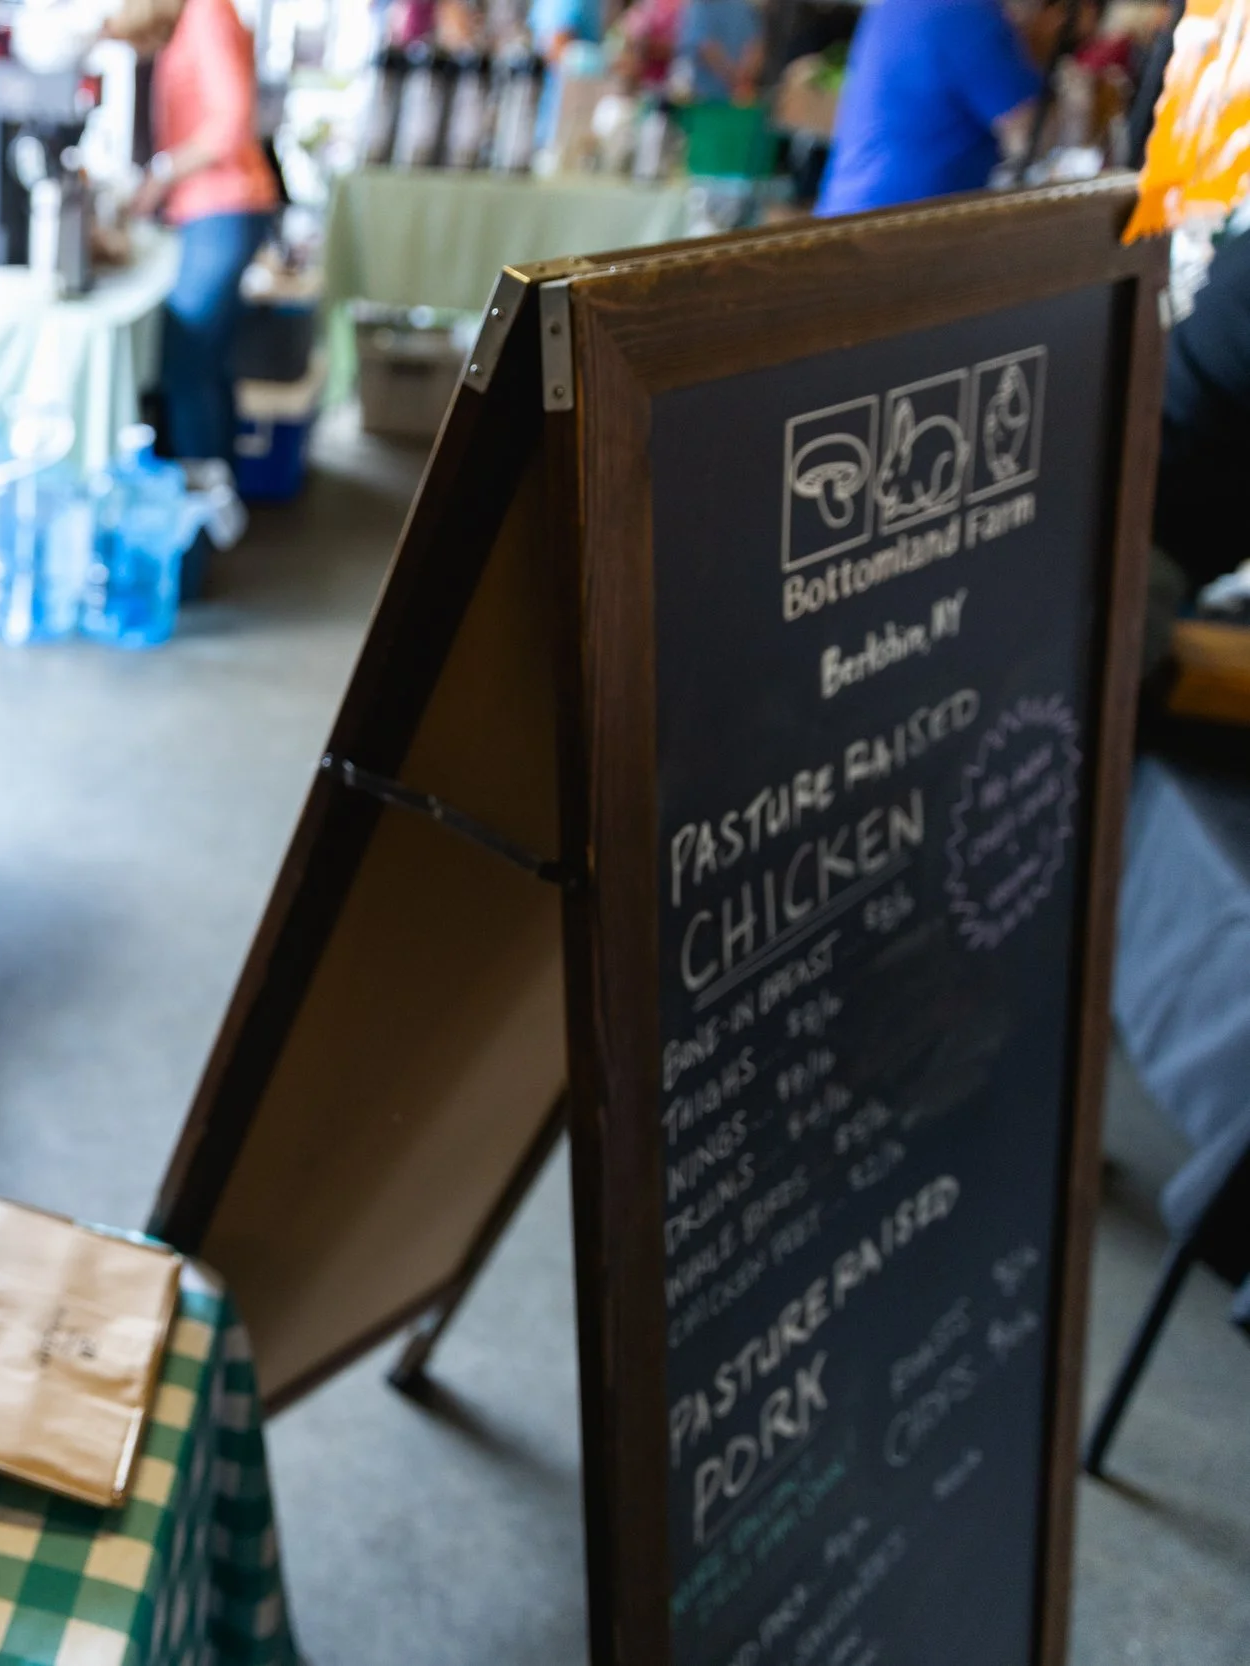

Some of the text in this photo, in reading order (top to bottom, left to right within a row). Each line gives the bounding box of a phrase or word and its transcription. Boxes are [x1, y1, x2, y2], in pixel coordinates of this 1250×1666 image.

[782, 492, 1037, 621] Bottomland Farm
[670, 762, 835, 907] PASTURE
[845, 688, 980, 790] RAISED
[680, 787, 925, 992] CHICKEN
[661, 1045, 757, 1145] THIGHS
[667, 1109, 747, 1203] WINGS
[669, 1174, 961, 1468] PASTURE RAISED
[693, 1351, 828, 1545] PORK
